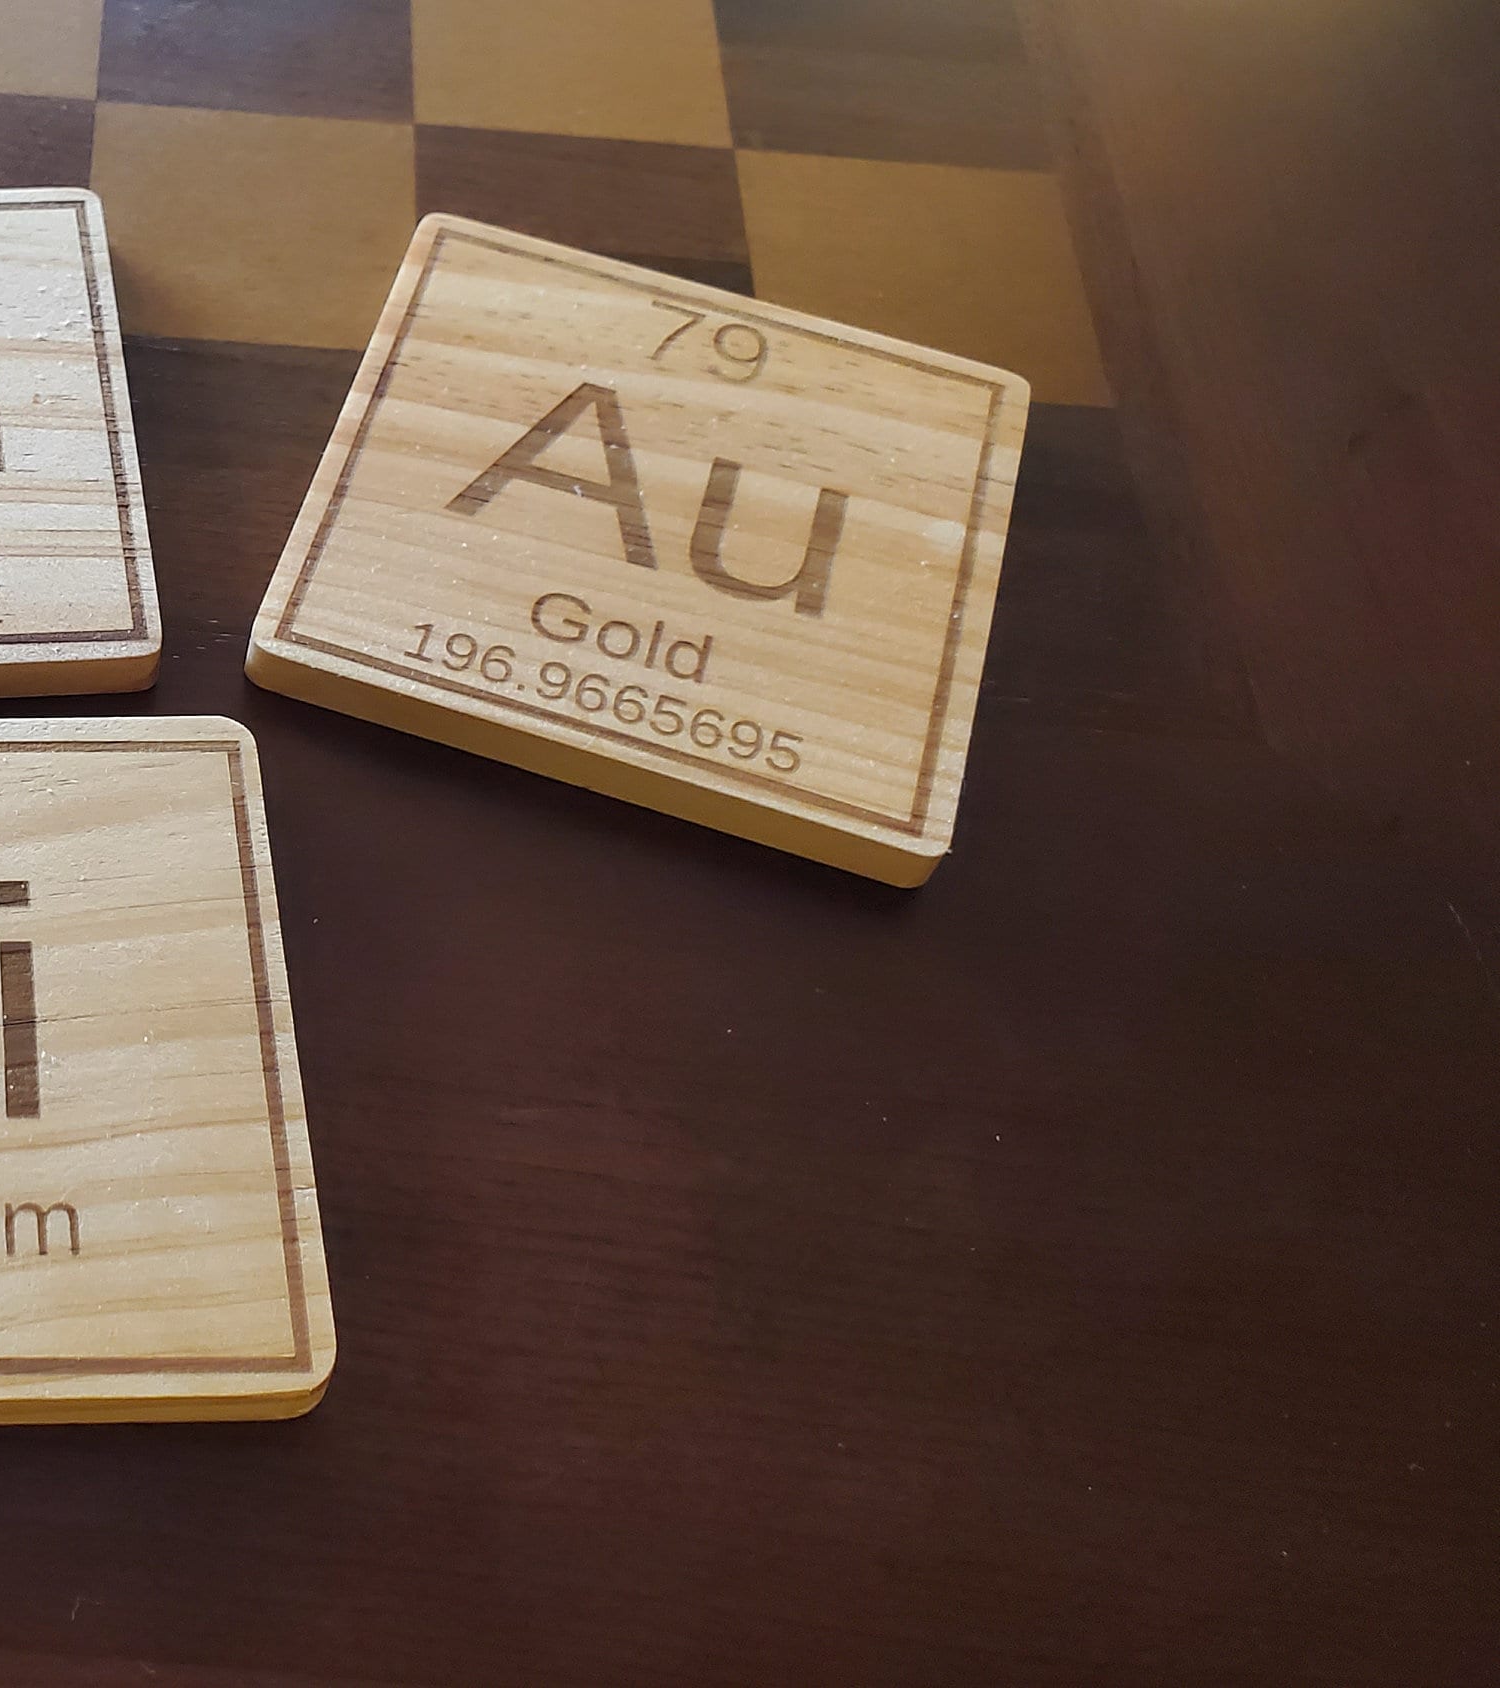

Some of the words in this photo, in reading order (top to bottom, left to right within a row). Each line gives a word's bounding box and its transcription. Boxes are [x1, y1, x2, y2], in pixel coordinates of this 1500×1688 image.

[650, 299, 769, 384] 79
[444, 382, 849, 619] Au
[404, 622, 805, 774] 196.9665695
[529, 591, 713, 684] Gold
